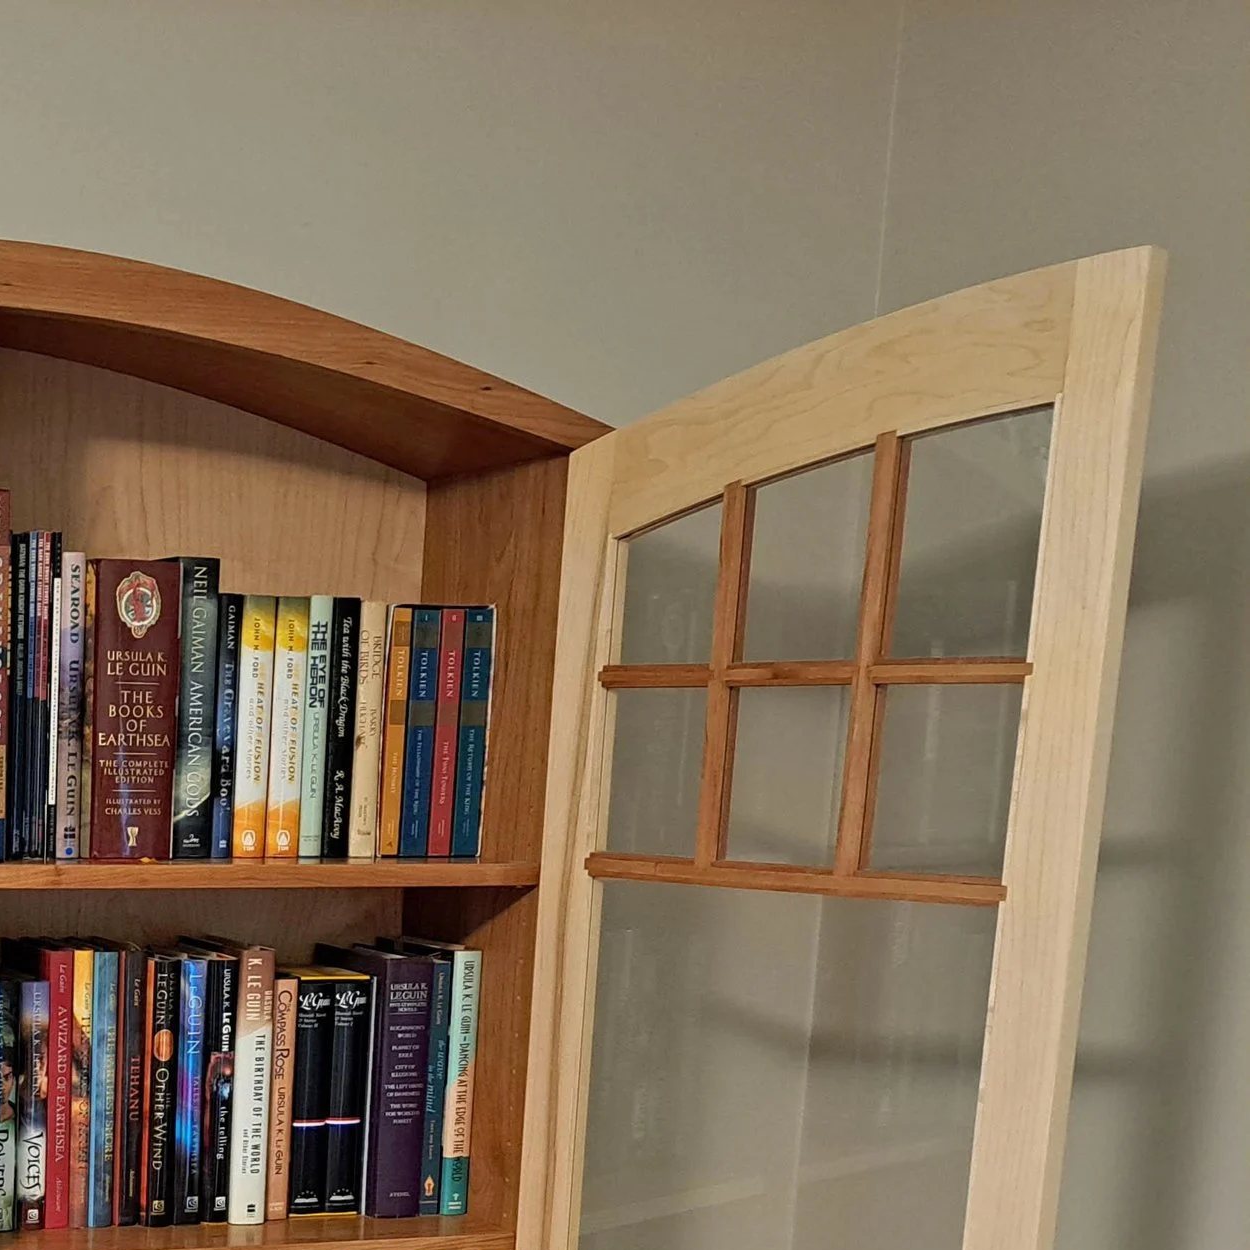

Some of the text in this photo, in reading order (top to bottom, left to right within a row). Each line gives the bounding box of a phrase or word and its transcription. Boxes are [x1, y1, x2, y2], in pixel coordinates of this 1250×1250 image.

[69, 564, 81, 643] SEAROAD
[107, 651, 166, 661] URSULA K.
[107, 663, 167, 676] LE GUIN
[309, 621, 321, 709] THE HERON
[318, 621, 328, 709] THE EYE OF
[396, 650, 406, 696] TOLKIEN
[418, 651, 429, 697] TOLKIEN
[445, 651, 456, 697] TOLKIEN
[470, 651, 481, 697] TOLKIEN
[109, 704, 163, 718] BOOKS
[120, 691, 152, 704] THE
[184, 566, 207, 816] NEIL GAIMAN AMERICAN GODS
[98, 732, 170, 746] EARTHSEA
[126, 719, 148, 732] OF
[245, 958, 263, 1021] K. LE GUIN
[54, 1005, 68, 1162] A WIZARD OF EARTHSEA
[250, 1034, 266, 1174] THE BIRTHDAY OF THE WORLD
[24, 1132, 45, 1190] VOICES
